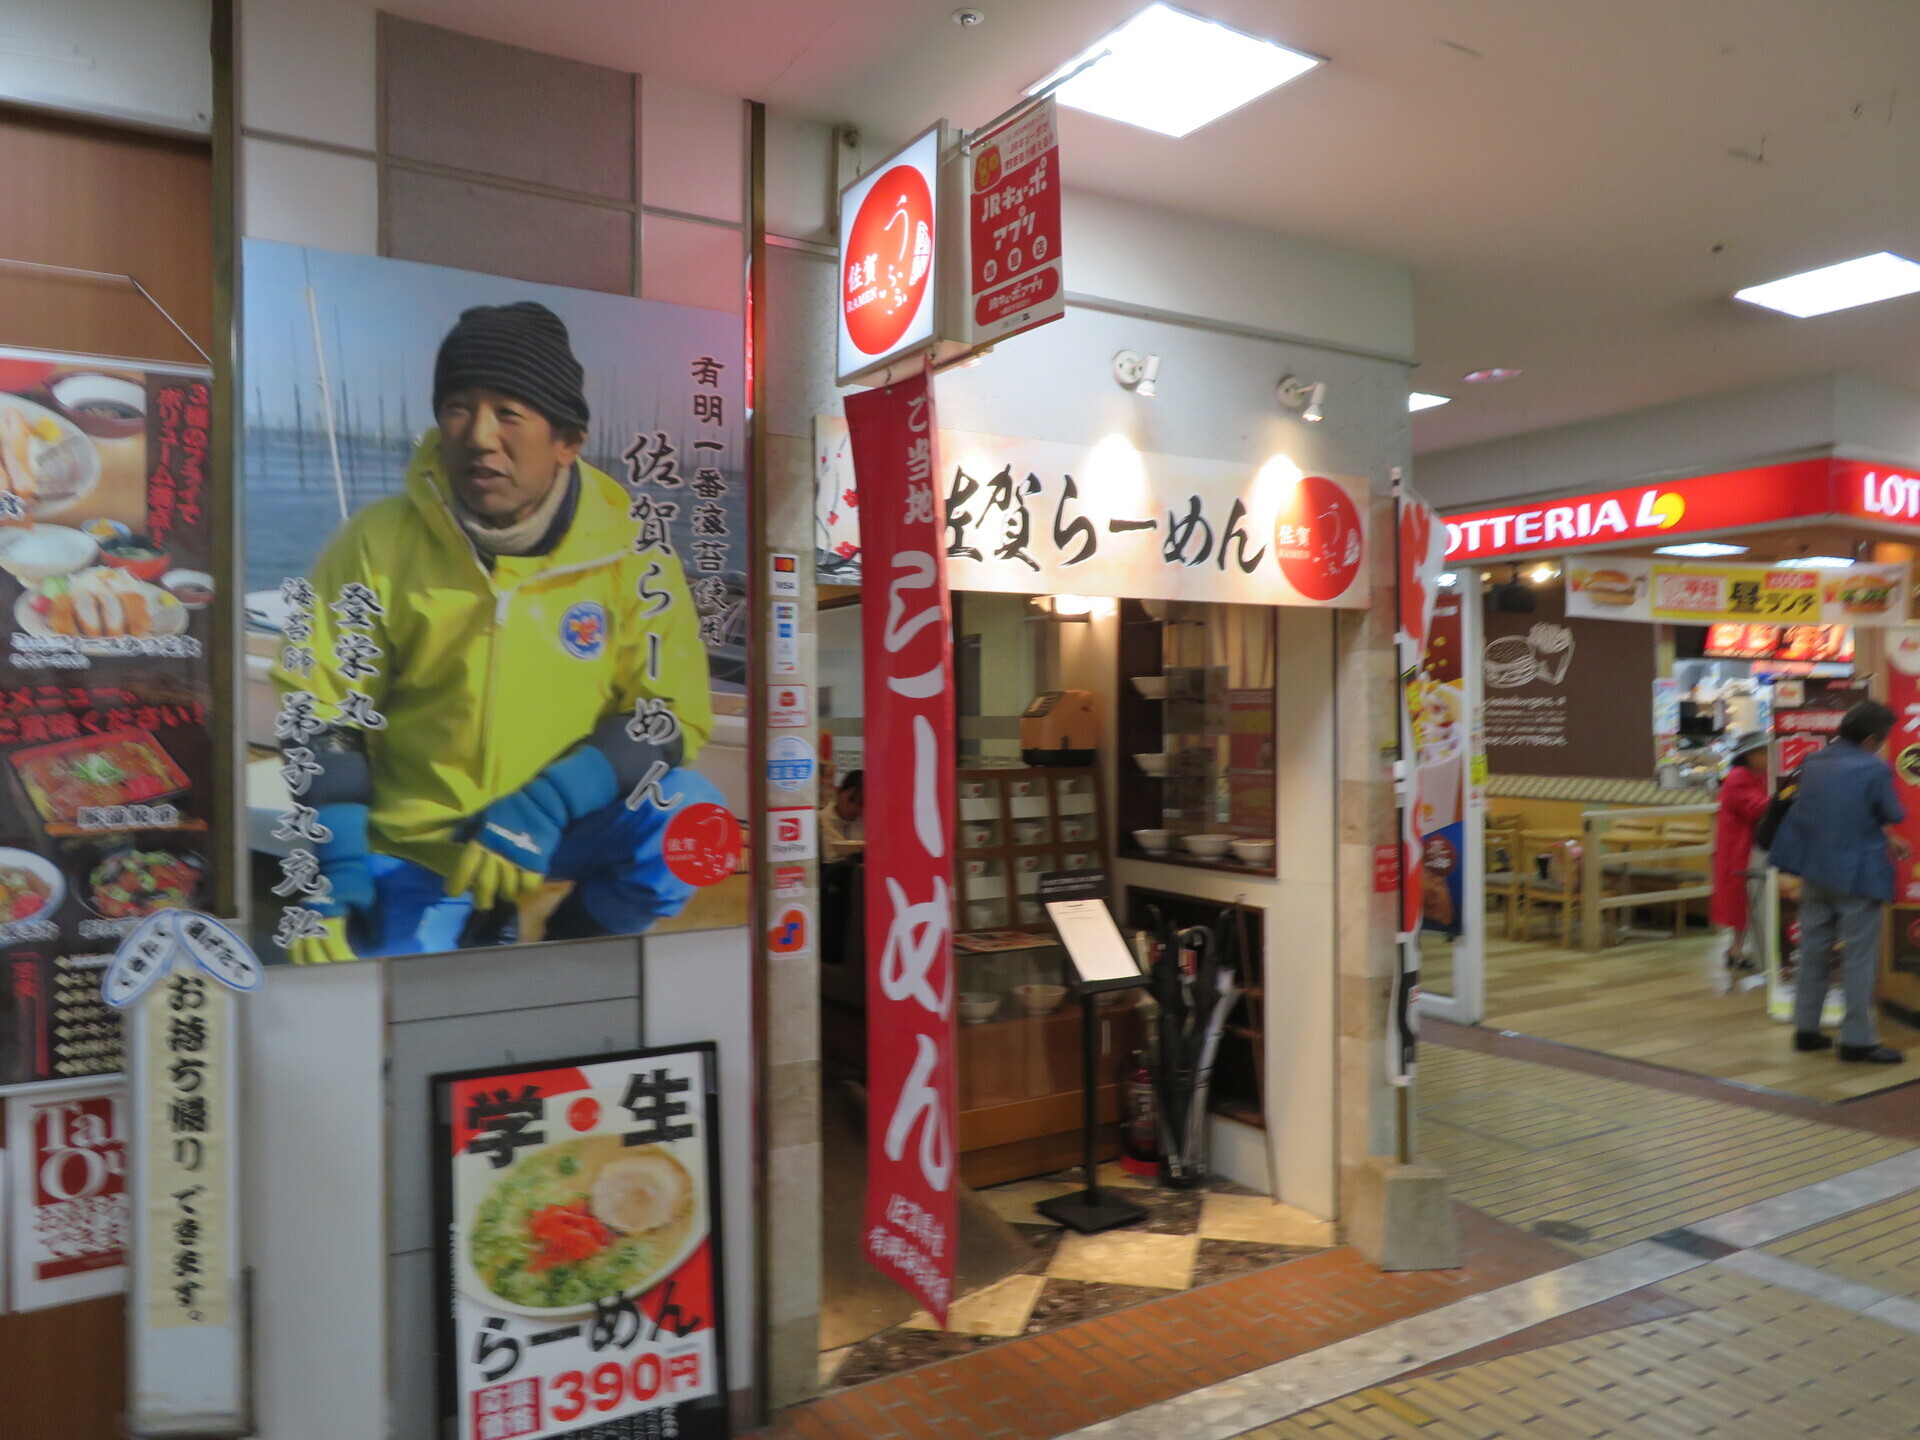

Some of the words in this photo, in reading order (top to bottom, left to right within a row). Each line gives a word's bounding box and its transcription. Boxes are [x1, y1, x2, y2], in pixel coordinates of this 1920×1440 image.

[982, 156, 1048, 223] JRキューポ
[993, 205, 1036, 251] アプリ
[848, 253, 879, 292] 佐賀
[691, 356, 730, 646] 有明一番海苔使用
[1444, 499, 1630, 557] OTTERIA
[1863, 471, 1920, 519] LOT
[623, 432, 685, 811] 佐賀らーめん
[472, 1280, 704, 1382] らーめん
[550, 1352, 700, 1422] 390円
